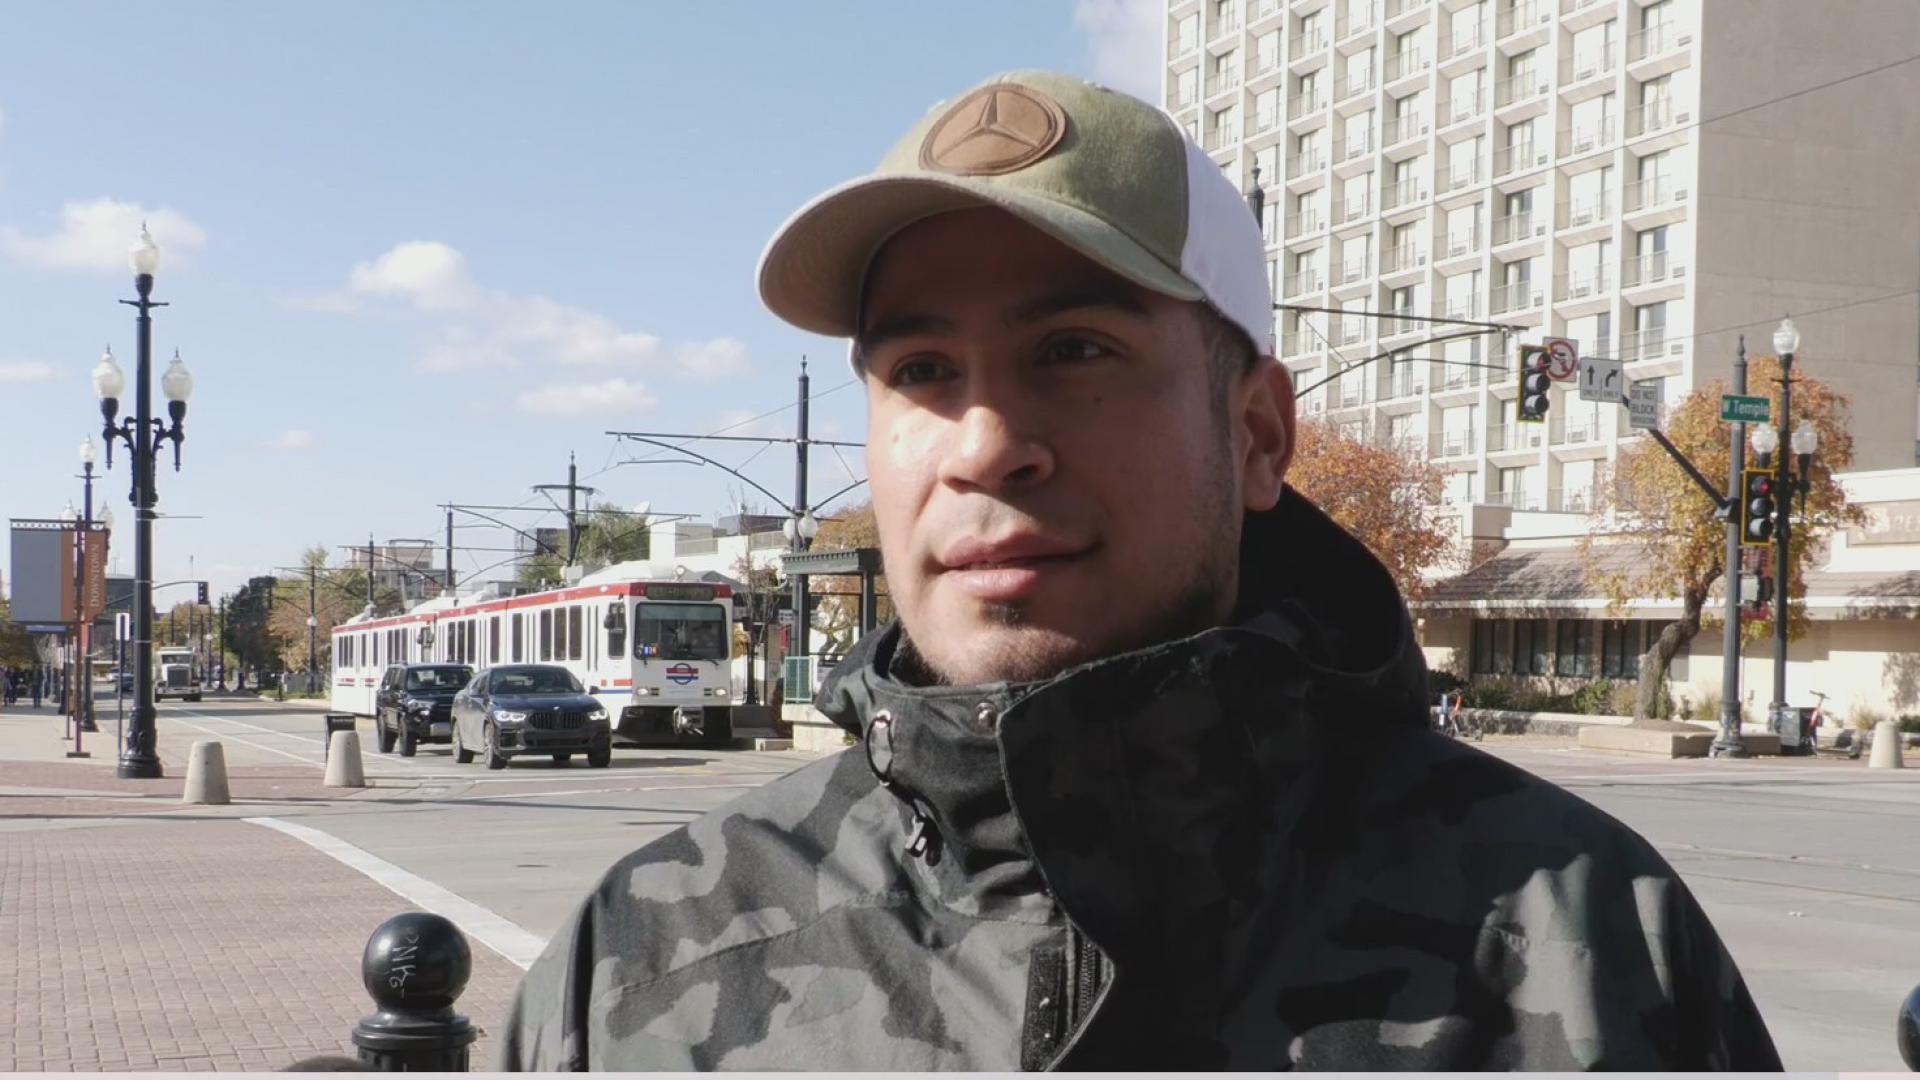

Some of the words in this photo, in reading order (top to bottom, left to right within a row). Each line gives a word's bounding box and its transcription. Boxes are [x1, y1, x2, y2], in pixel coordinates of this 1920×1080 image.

[1631, 404, 1655, 414] BLOCK
[1733, 399, 1769, 418] Temple
[91, 544, 100, 607] DOWNTOWN
